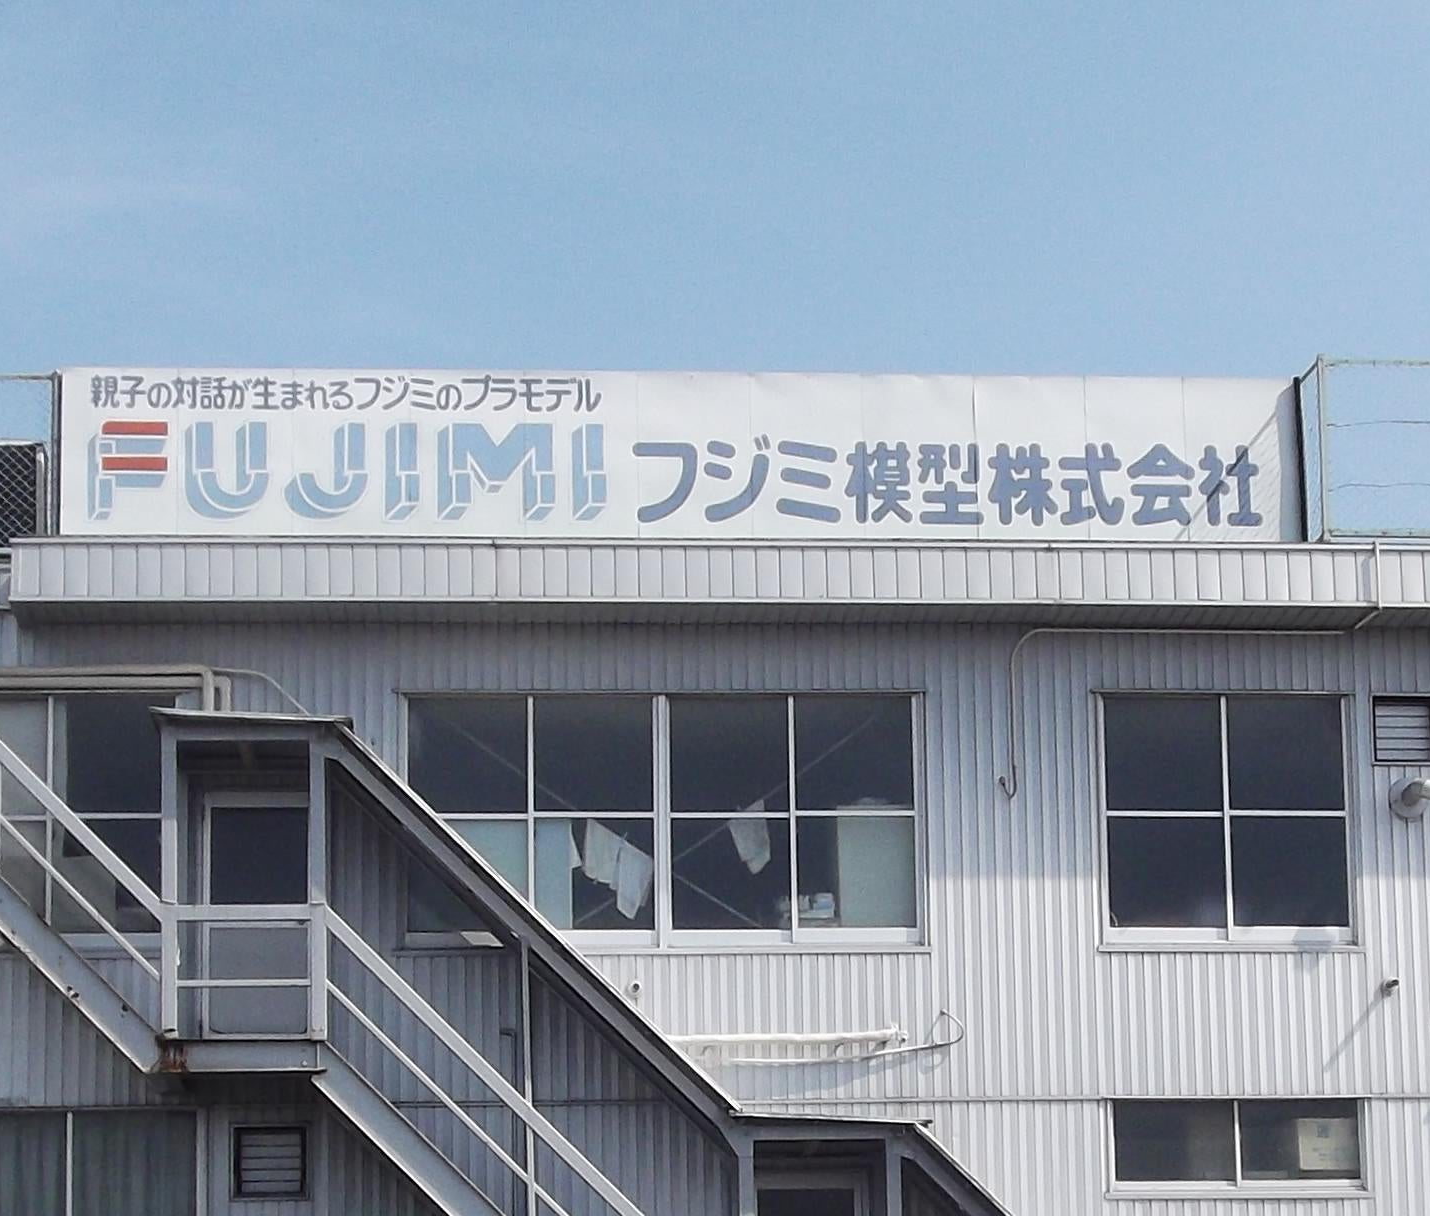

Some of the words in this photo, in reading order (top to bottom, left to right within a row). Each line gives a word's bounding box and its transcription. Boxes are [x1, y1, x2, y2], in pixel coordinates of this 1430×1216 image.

[91, 375, 602, 411] 親子の対話が生まれるフジミのプラモデル
[87, 420, 608, 522] FUJIMI
[632, 429, 1263, 527] フジミ模型株式会社
